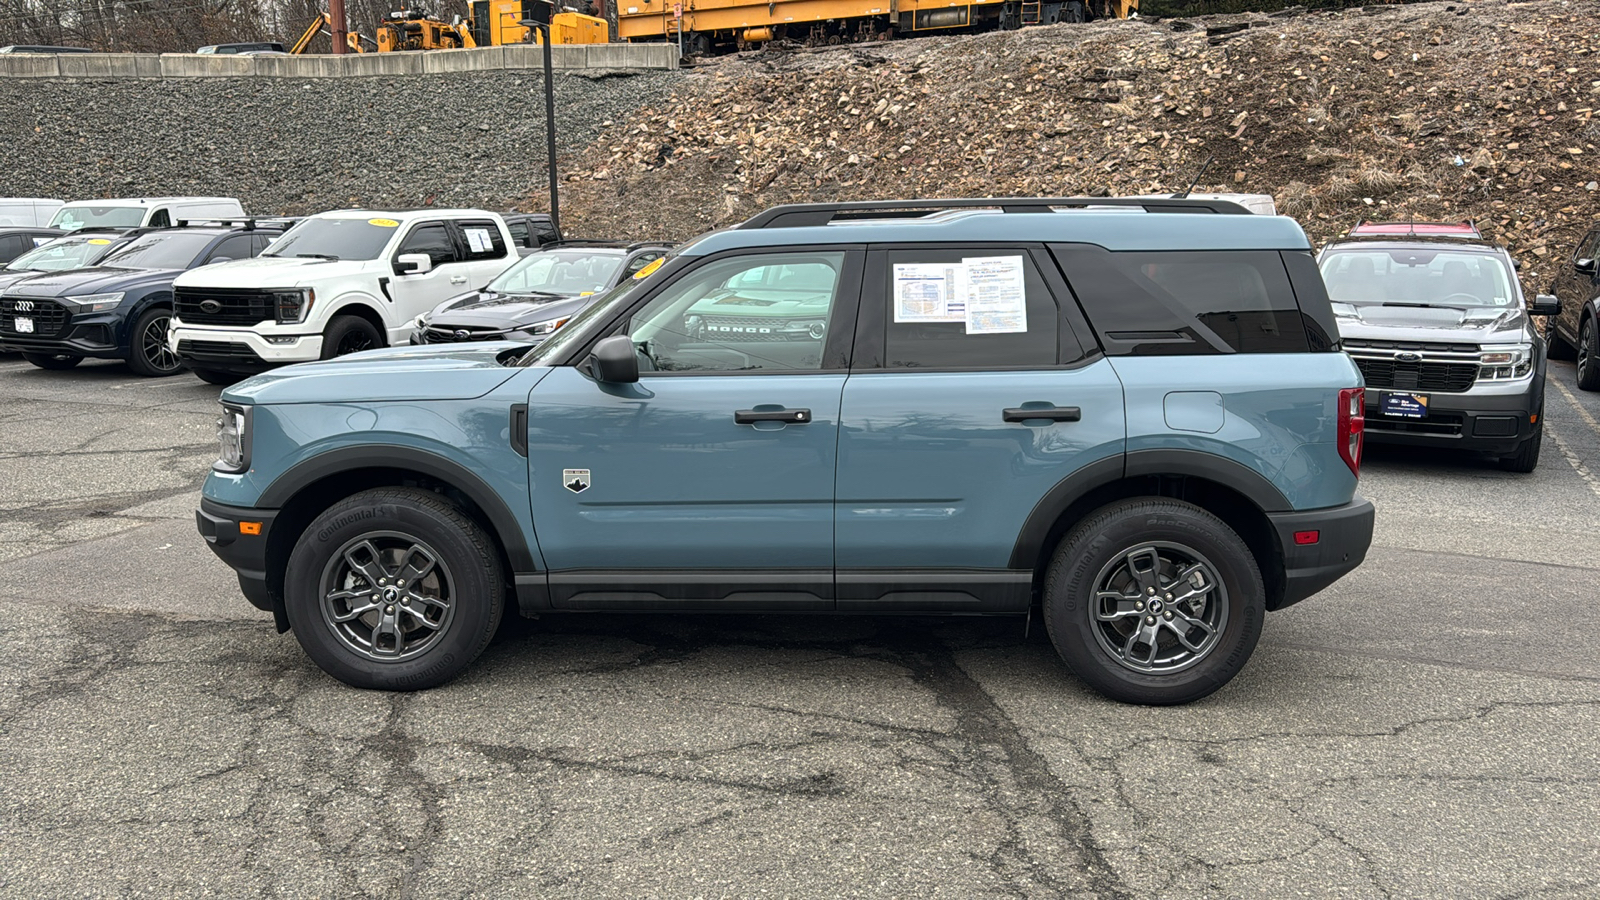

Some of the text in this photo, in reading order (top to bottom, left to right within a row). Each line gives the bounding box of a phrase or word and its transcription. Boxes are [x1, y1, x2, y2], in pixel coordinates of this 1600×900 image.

[317, 507, 377, 543] Continental
[1065, 551, 1097, 612] Continental
[1225, 605, 1257, 668] Continental
[394, 652, 456, 687] Continental
